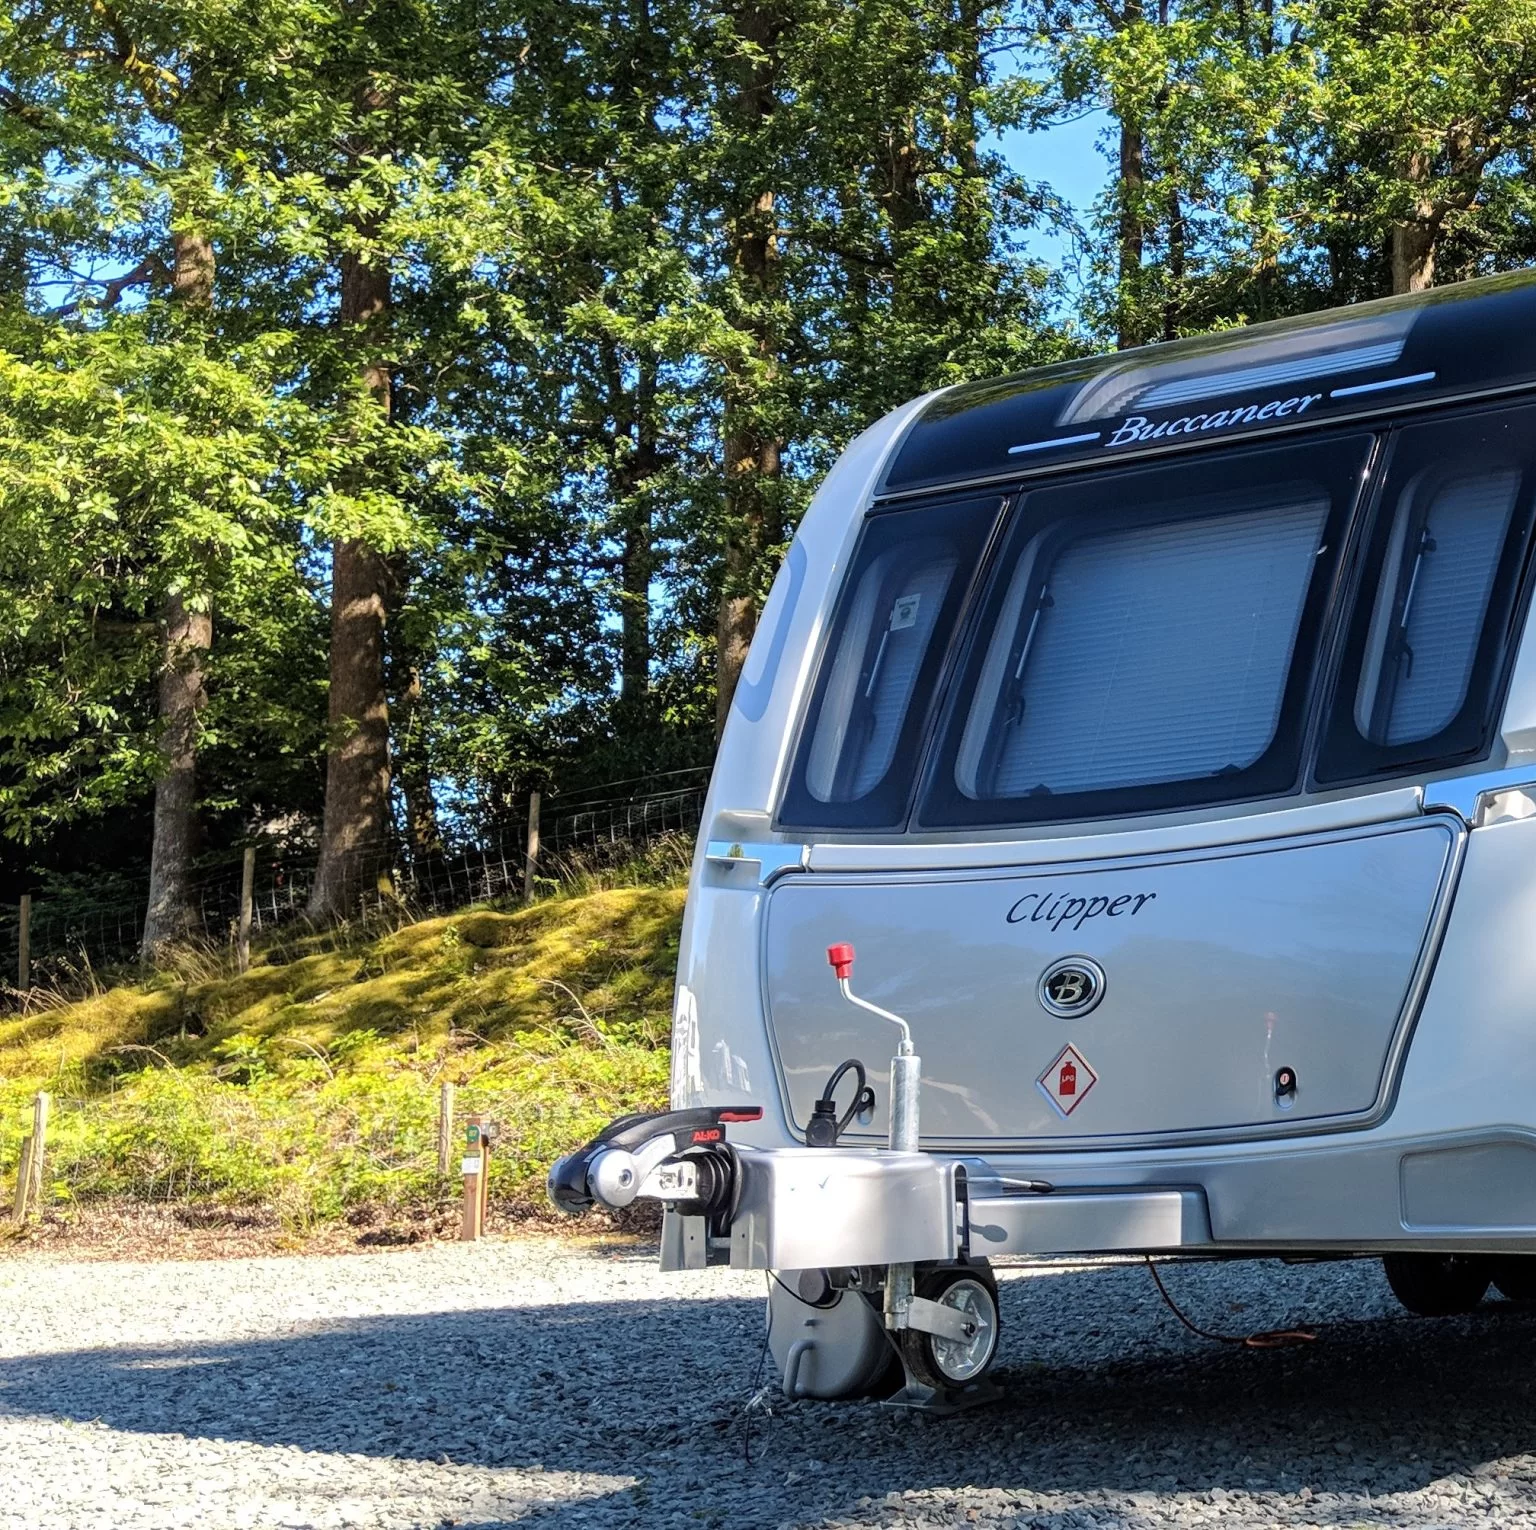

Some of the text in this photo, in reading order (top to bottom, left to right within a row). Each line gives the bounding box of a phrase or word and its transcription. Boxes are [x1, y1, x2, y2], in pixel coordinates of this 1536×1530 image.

[1104, 393, 1322, 447] Buccaneer
[1006, 892, 1157, 932] Clipper
[1054, 971, 1087, 1003] B
